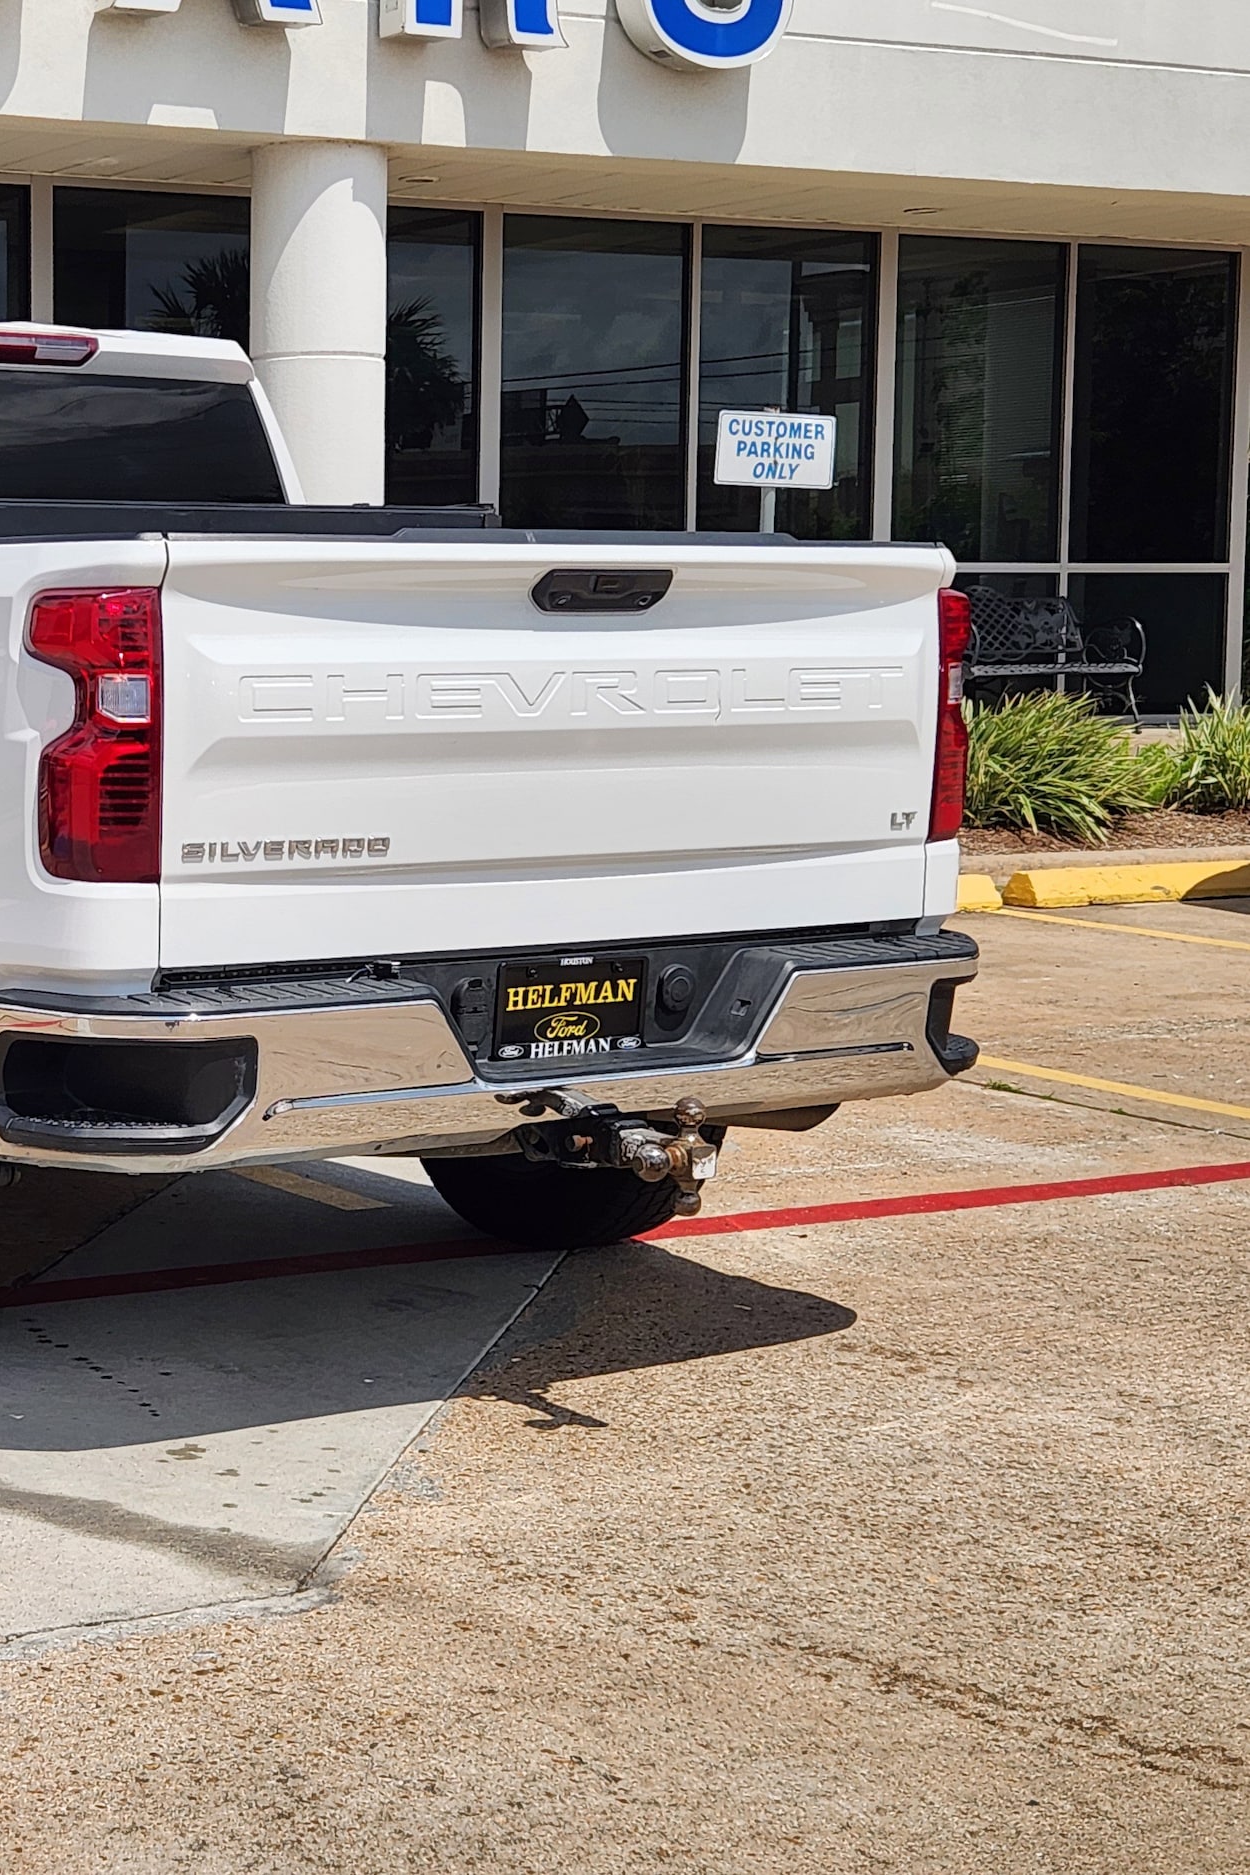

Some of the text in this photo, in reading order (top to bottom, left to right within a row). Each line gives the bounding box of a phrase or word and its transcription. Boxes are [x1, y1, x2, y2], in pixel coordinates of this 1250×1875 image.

[728, 418, 825, 440] CUSTOMER
[736, 440, 815, 461] PARKING
[752, 462, 800, 480] ONLY
[238, 666, 904, 723] CHEVROLET
[890, 811, 918, 831] LT
[181, 836, 391, 864] SILVERADO
[505, 978, 638, 1012] HELFMAN
[546, 1015, 589, 1039] Ford
[529, 1036, 612, 1059] HELFMAN
